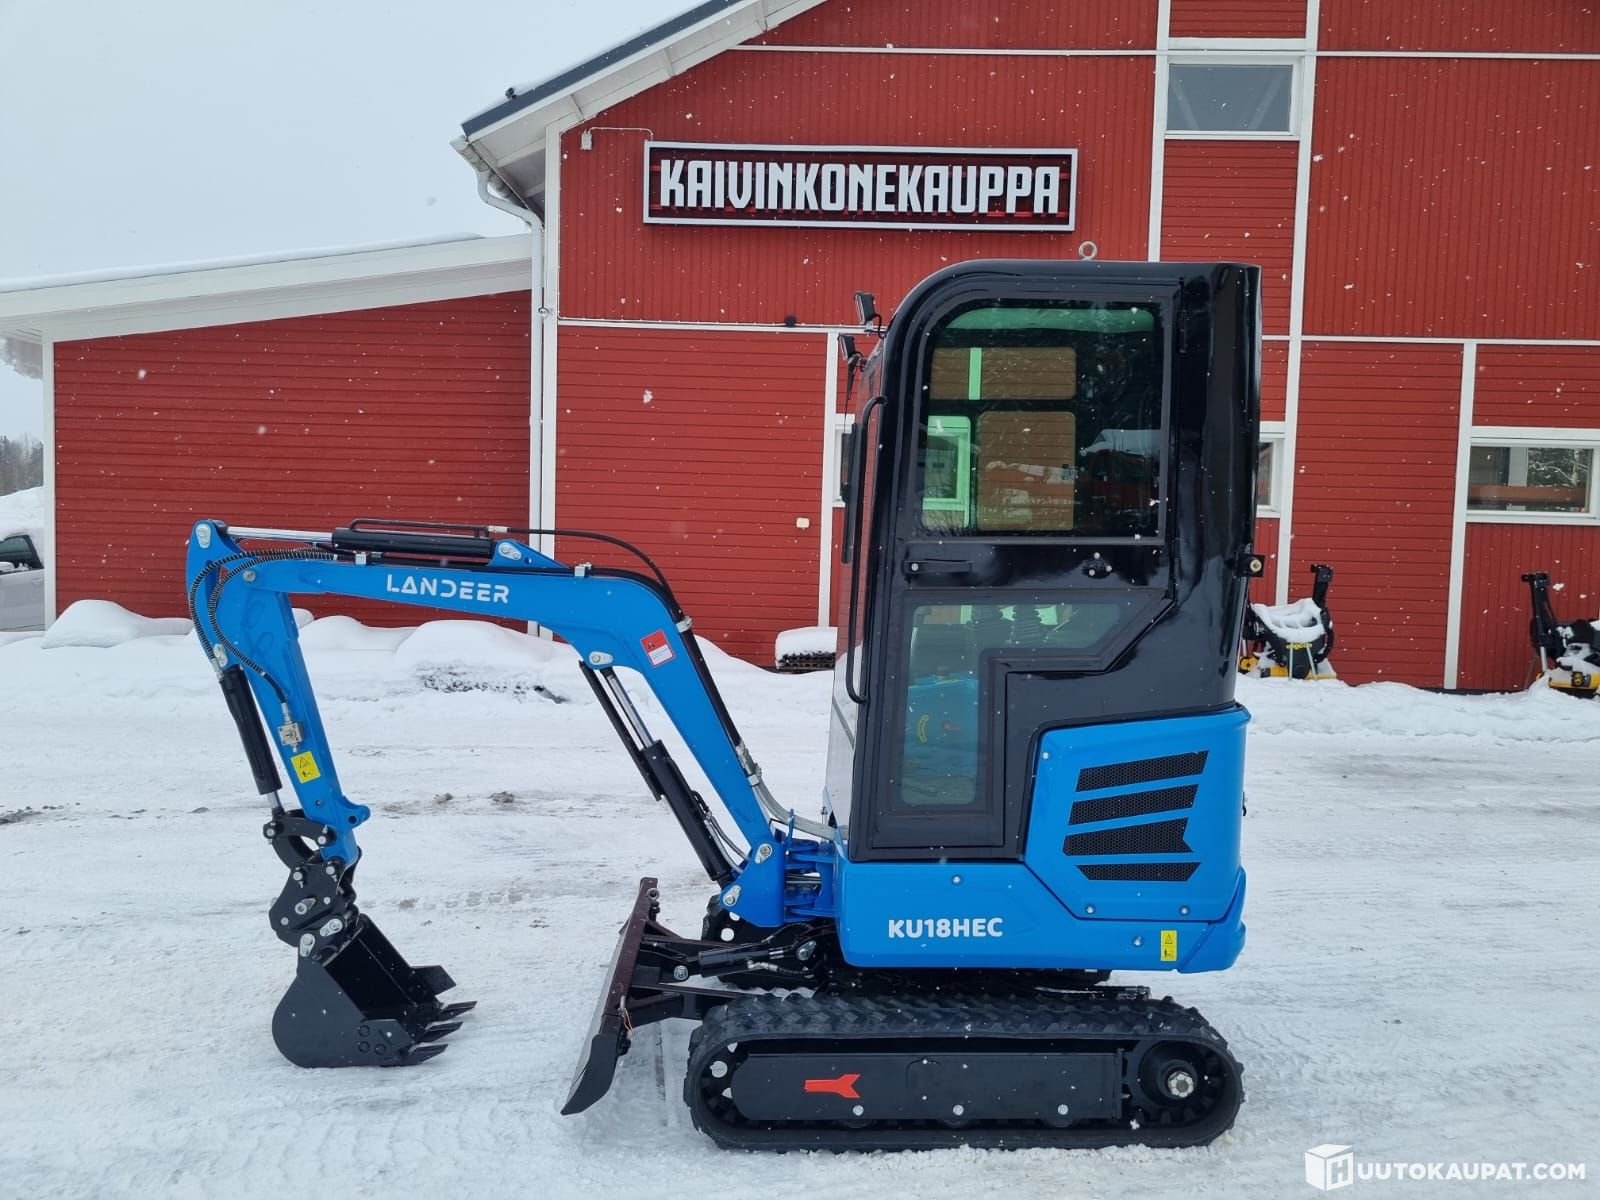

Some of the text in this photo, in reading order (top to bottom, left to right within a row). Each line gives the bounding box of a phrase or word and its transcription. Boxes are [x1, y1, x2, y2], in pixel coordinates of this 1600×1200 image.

[660, 159, 1060, 214] KAIVINKONEKAUPPA
[386, 574, 510, 604] LANDEER
[888, 917, 1003, 938] KU18HEC
